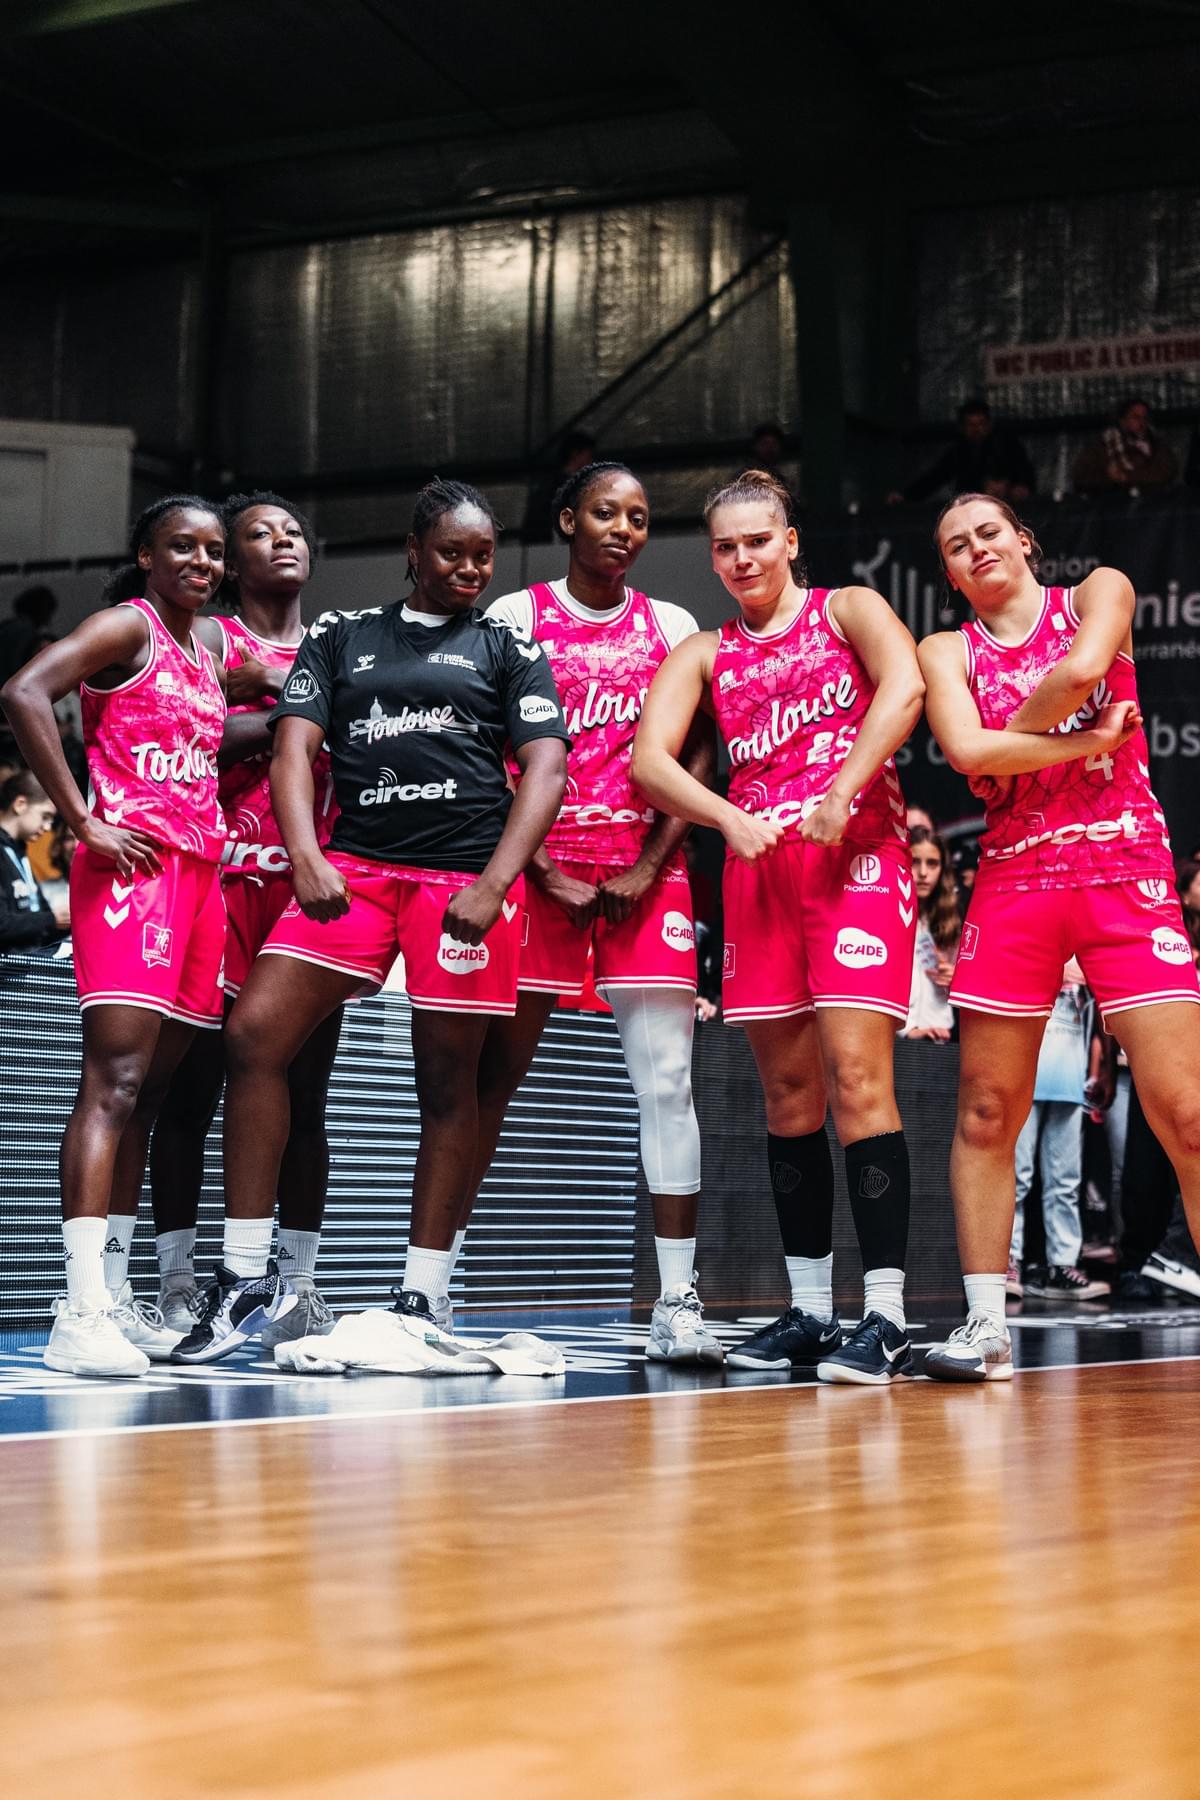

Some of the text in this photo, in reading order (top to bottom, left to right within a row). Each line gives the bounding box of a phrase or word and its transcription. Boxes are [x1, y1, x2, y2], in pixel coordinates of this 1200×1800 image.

[522, 704, 554, 717] ICADE
[367, 705, 455, 745] Toulouse
[359, 778, 457, 806] circet
[843, 883, 890, 895] PROMOTION
[441, 948, 486, 962] ICADE
[838, 943, 883, 958] ICADE
